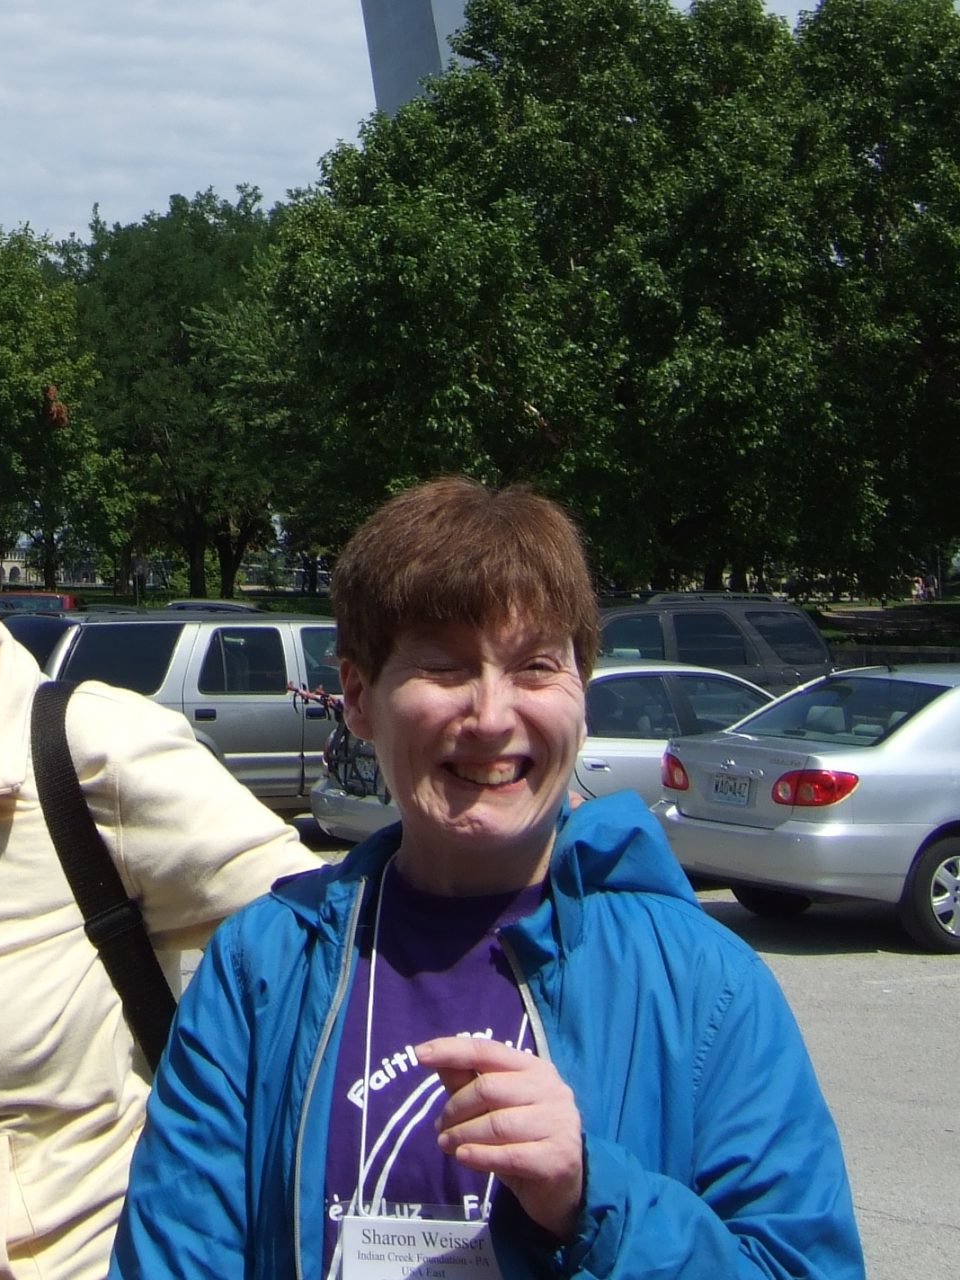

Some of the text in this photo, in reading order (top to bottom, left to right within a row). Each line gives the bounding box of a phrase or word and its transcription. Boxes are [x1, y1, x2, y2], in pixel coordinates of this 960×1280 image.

[381, 1198, 423, 1220] Luz
[362, 1228, 485, 1250] Sharon Weisser
[357, 1250, 385, 1261] Indian
[387, 1251, 413, 1262] Creek
[417, 1253, 467, 1265] Foundation
[475, 1257, 490, 1267] PA
[402, 1266, 446, 1278] USA East
